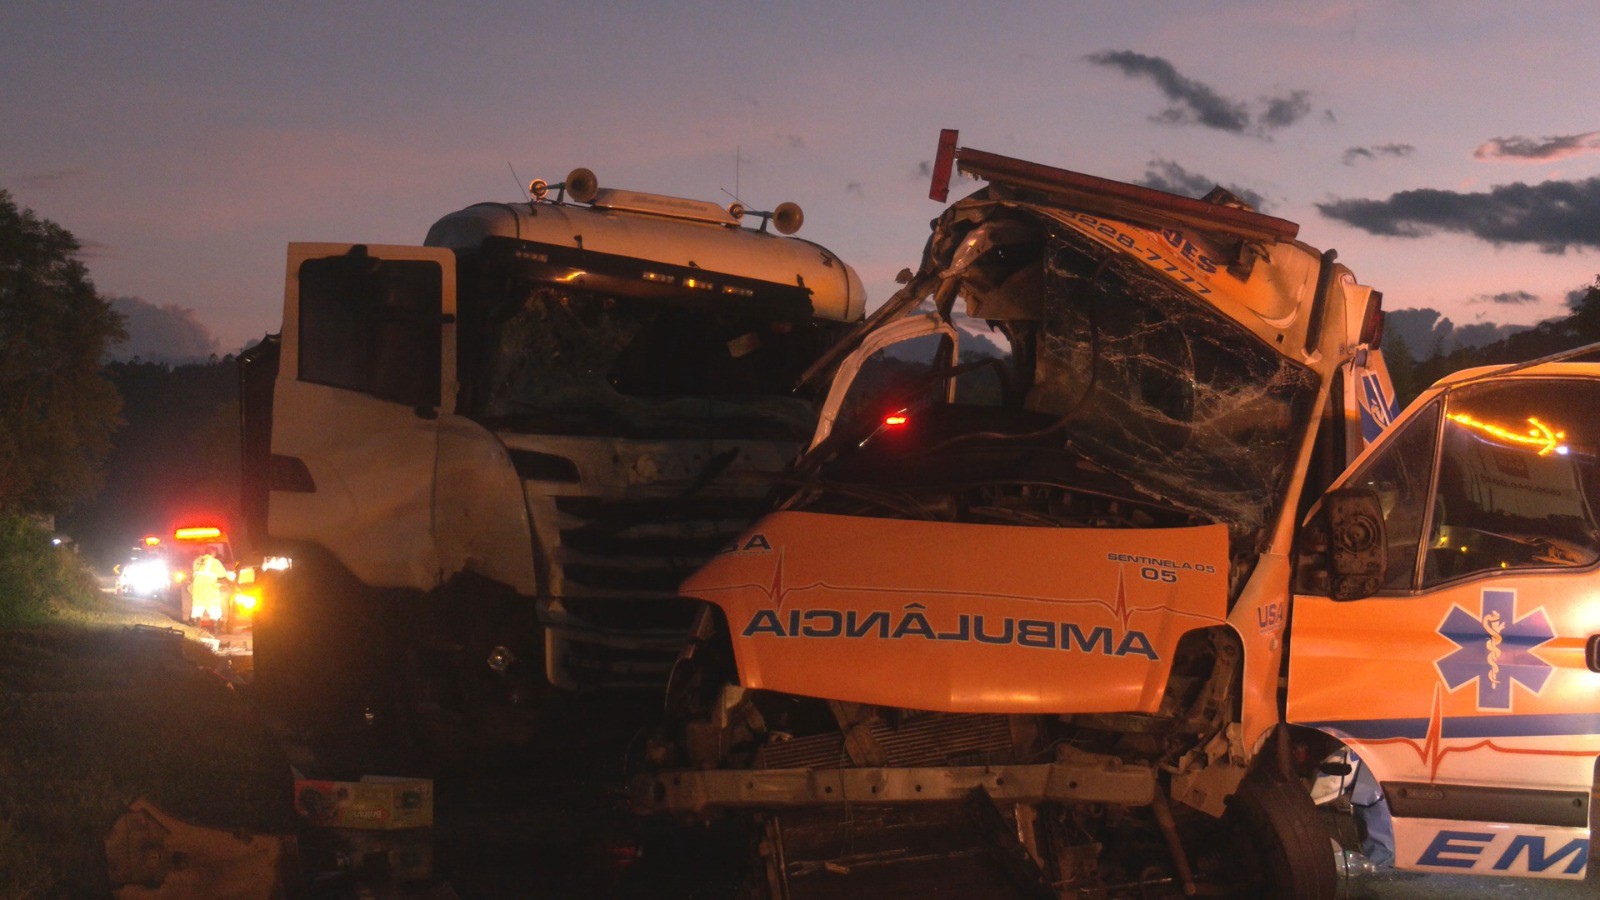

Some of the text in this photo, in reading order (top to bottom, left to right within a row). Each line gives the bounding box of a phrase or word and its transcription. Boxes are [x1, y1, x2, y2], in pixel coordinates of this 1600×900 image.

[1107, 552, 1215, 573] SENTINELA 05
[1140, 566, 1178, 584] 05
[1257, 603, 1283, 628] USA
